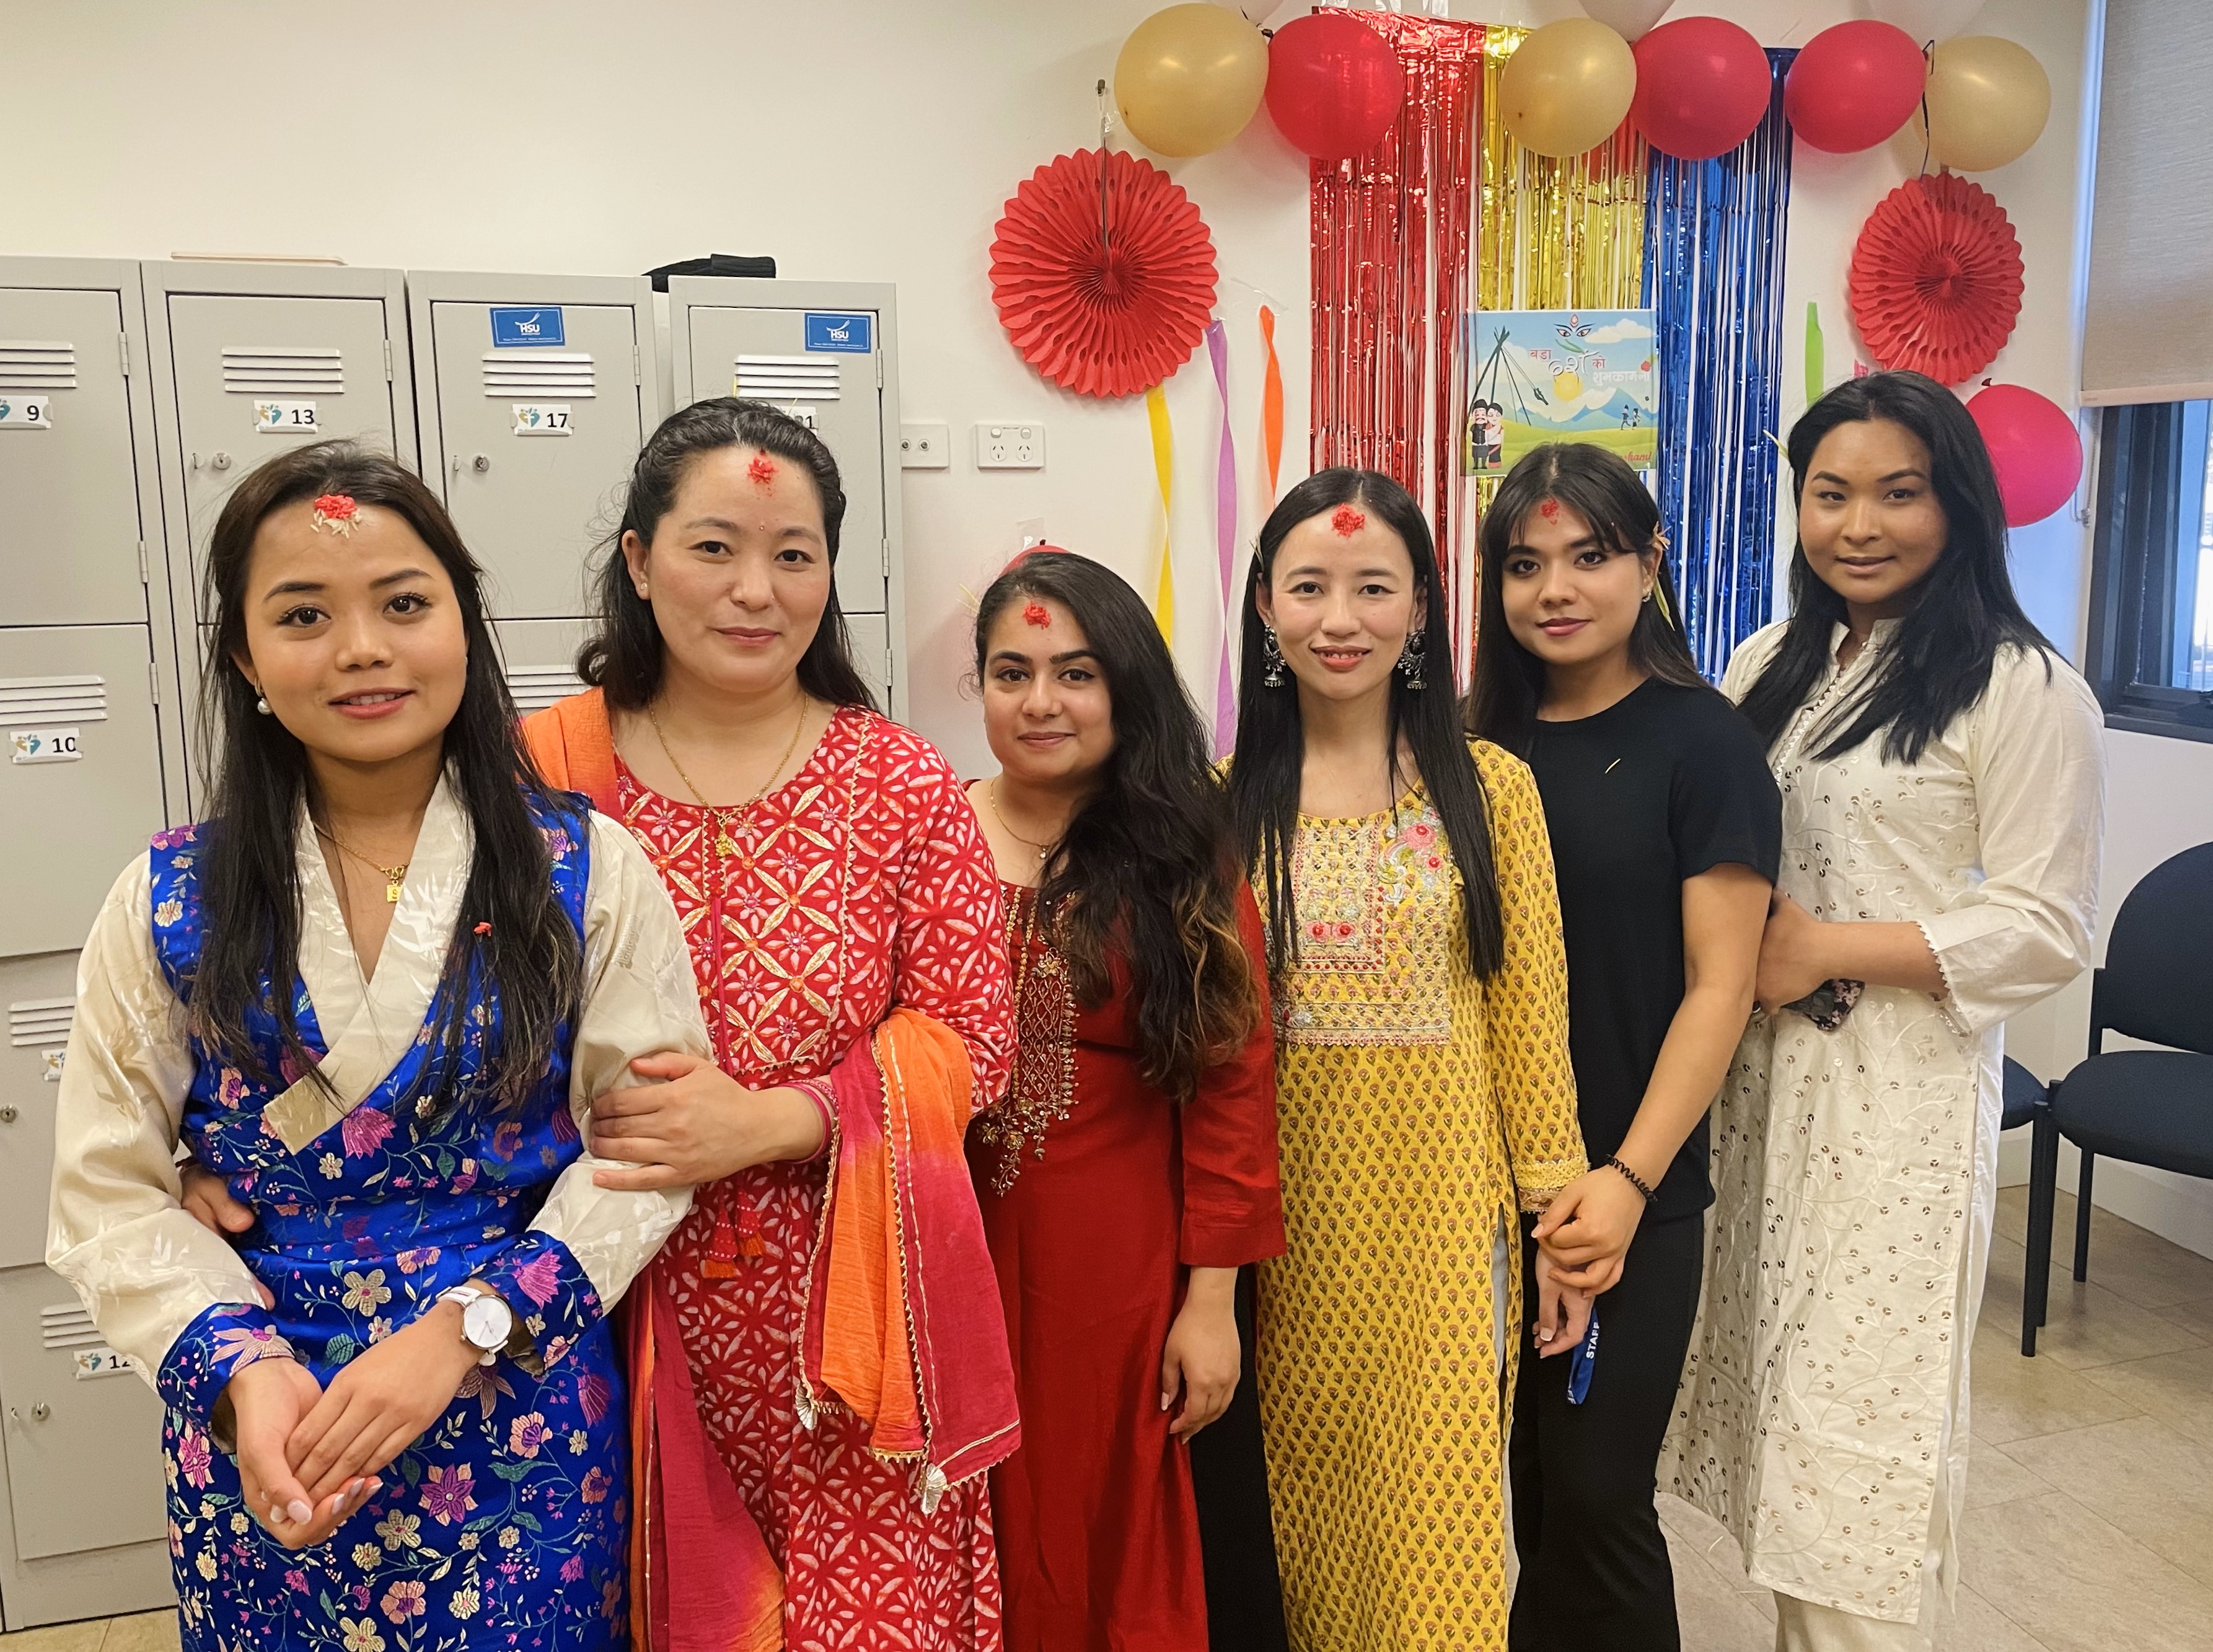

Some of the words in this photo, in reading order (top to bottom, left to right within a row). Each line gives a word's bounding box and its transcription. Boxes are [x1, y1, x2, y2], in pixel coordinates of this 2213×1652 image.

[519, 324, 540, 333] HSU
[830, 330, 850, 339] HSU
[1529, 348, 1552, 360] बडा
[1593, 355, 1606, 369] को
[27, 405, 40, 421] 9
[291, 409, 315, 424] 13
[547, 413, 568, 428] 17
[51, 737, 77, 753] 10
[1586, 1322, 1599, 1360] STAFF
